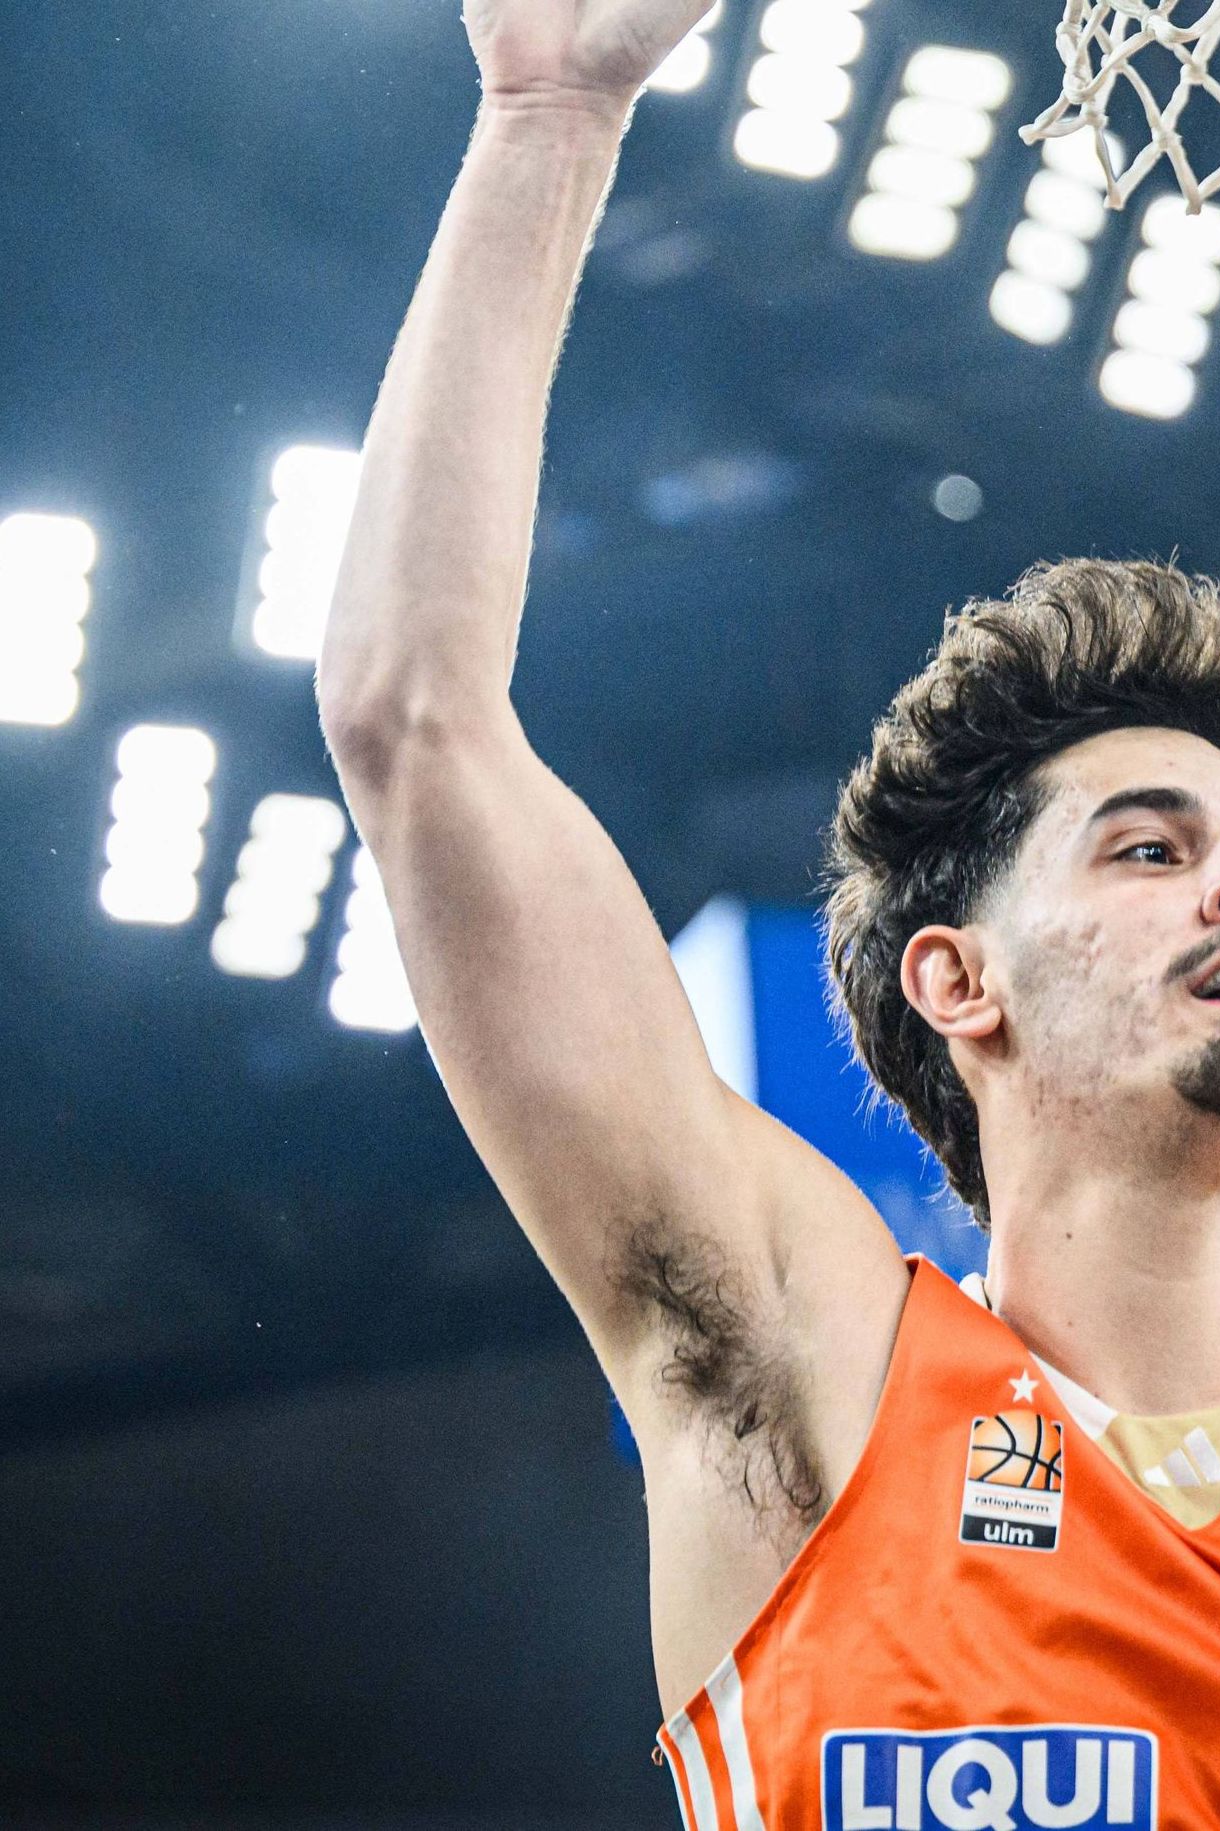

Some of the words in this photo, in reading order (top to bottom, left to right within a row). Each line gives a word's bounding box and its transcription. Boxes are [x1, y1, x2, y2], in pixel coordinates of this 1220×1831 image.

[975, 1496, 1049, 1512] ratiopharm
[984, 1522, 1034, 1544] ulm
[841, 1738, 1136, 1831] LIQUI
